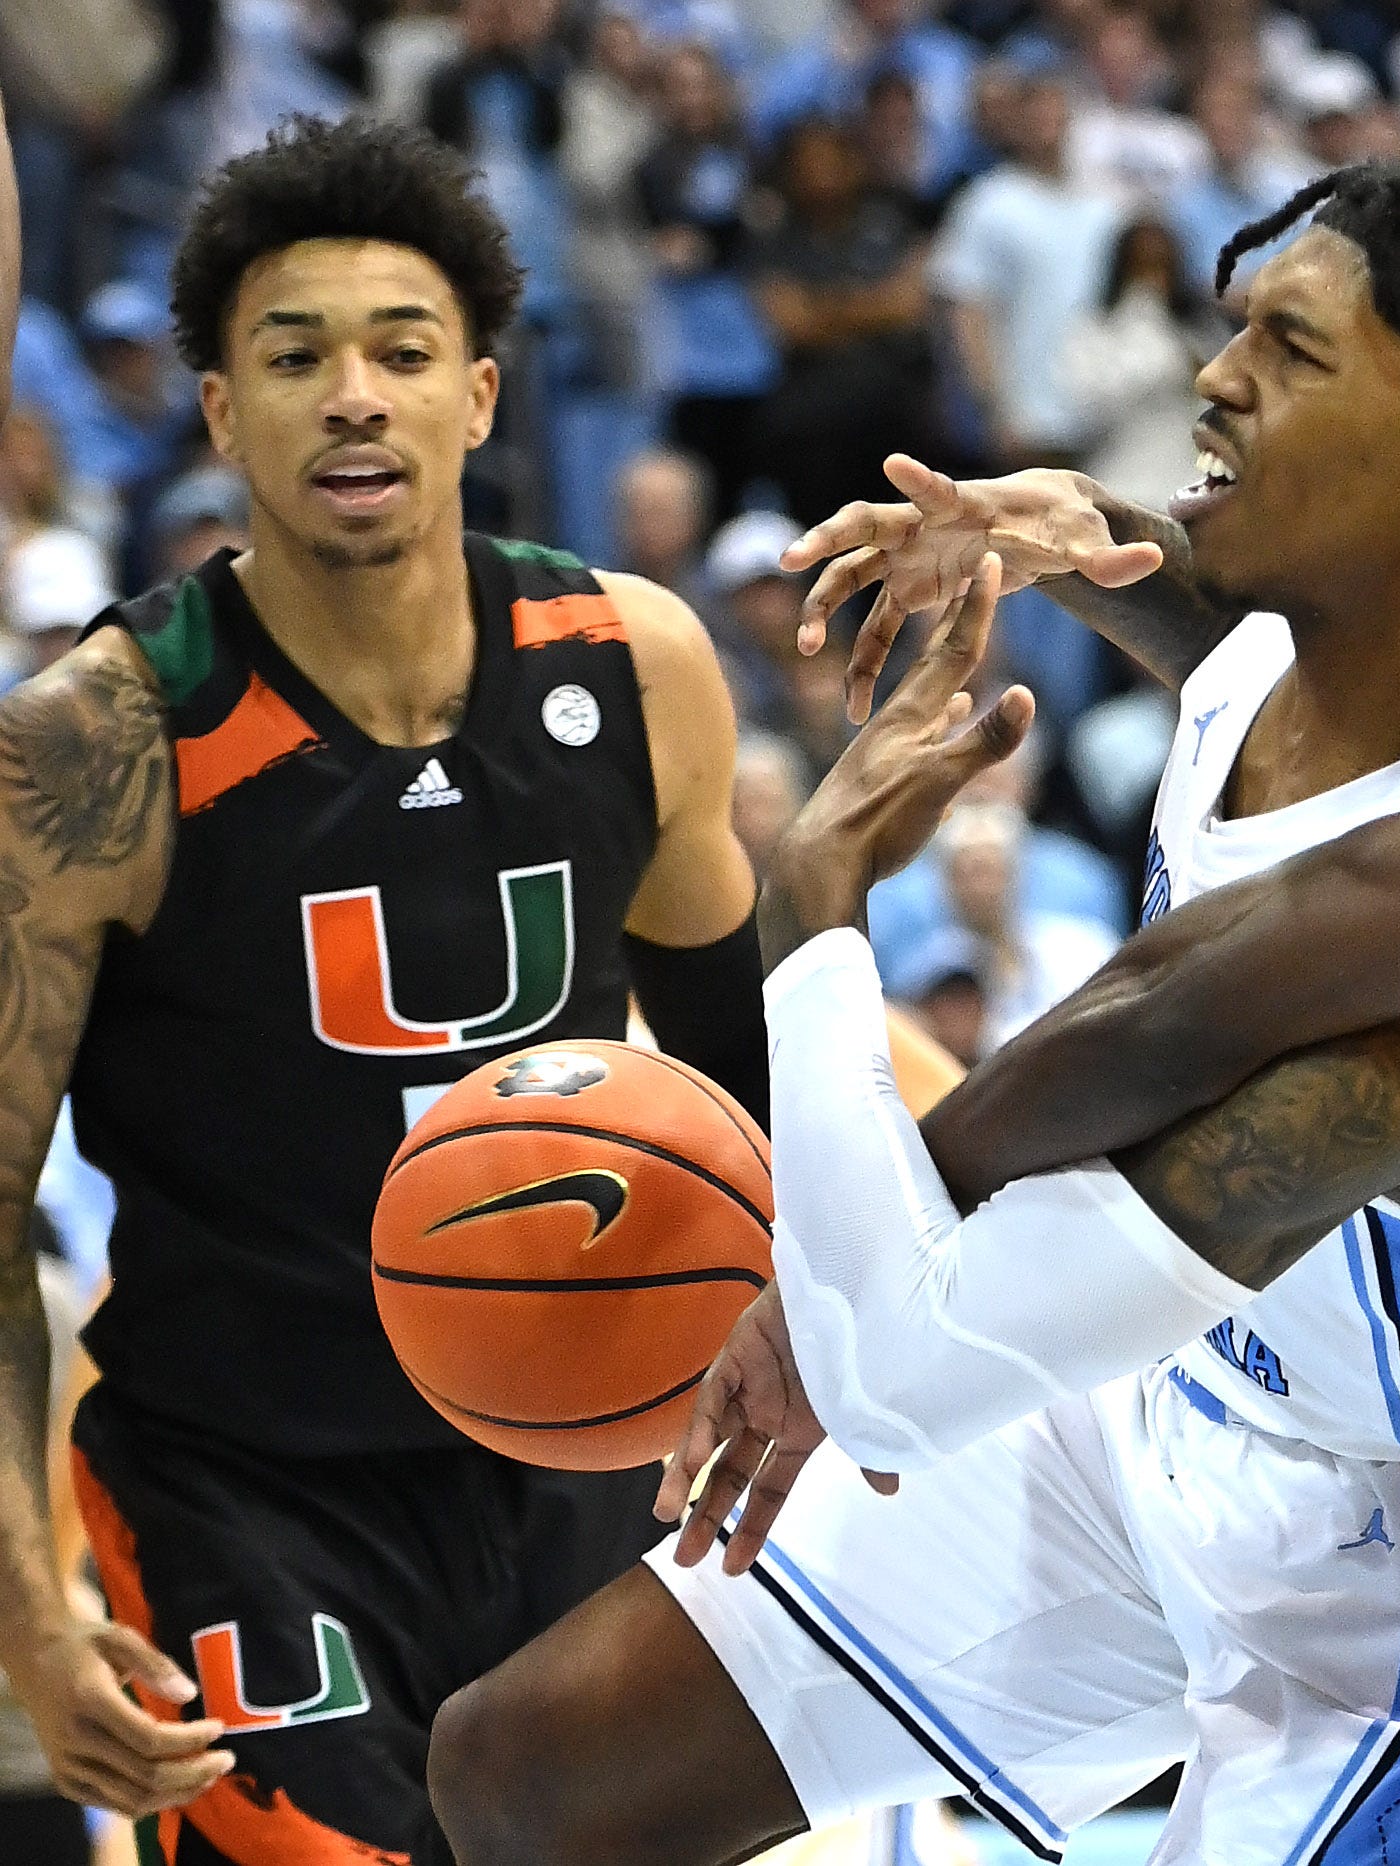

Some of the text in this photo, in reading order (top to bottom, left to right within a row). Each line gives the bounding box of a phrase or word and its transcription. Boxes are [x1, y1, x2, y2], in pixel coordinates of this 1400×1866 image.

[398, 787, 464, 810] adidas
[300, 859, 572, 1056] U
[190, 1611, 371, 1736] U
